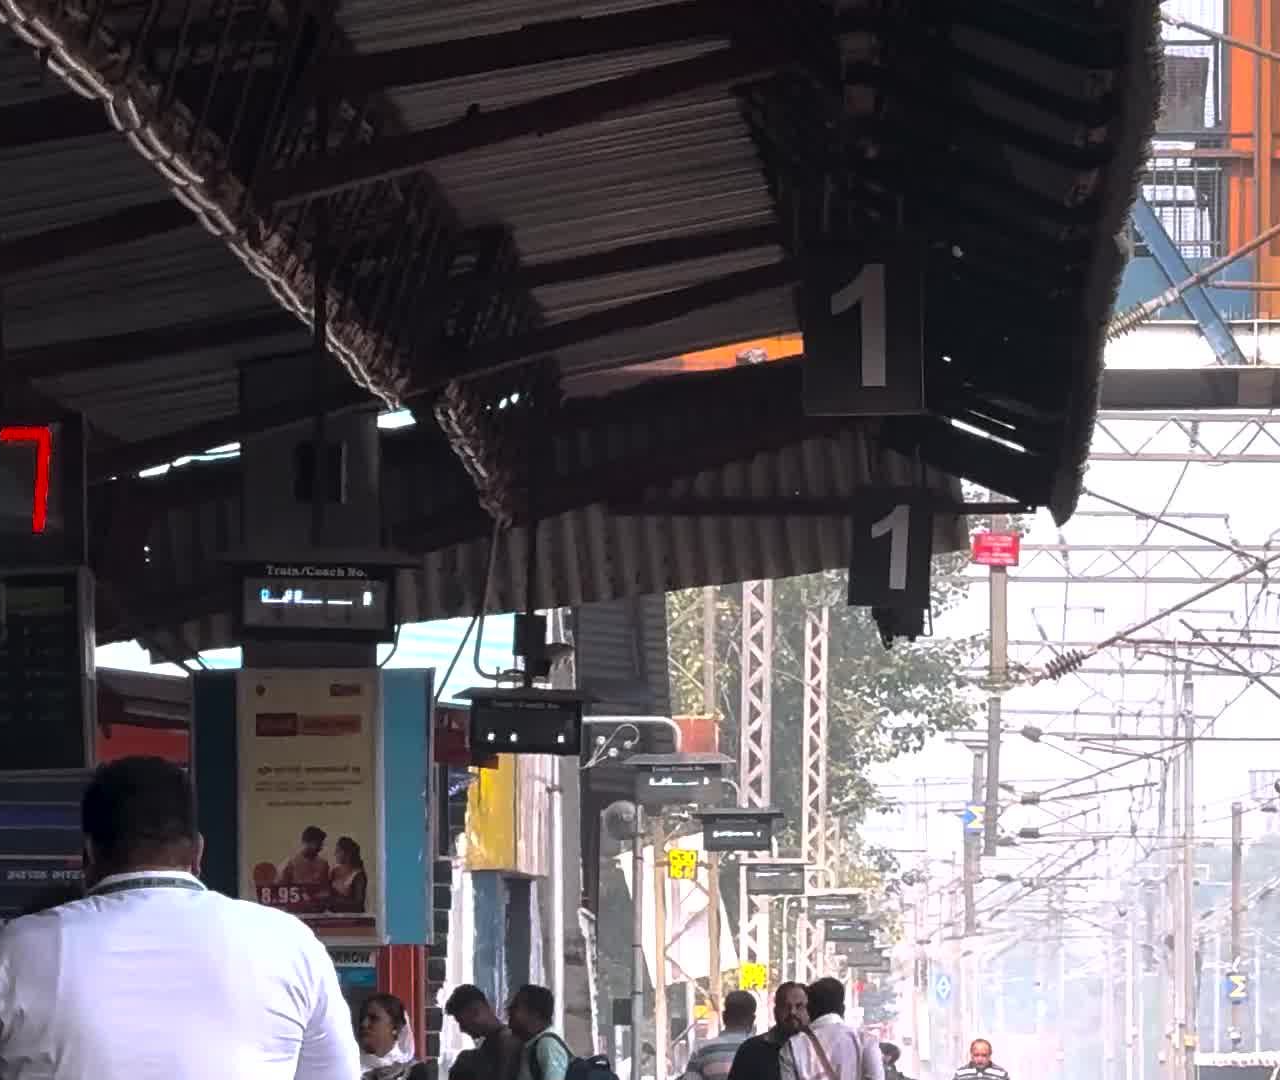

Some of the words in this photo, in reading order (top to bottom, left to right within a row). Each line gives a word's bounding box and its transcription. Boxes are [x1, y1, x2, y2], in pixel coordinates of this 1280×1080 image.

[830, 263, 887, 387] 1
[266, 565, 346, 577] Train/Coach
[871, 504, 911, 591] 1
